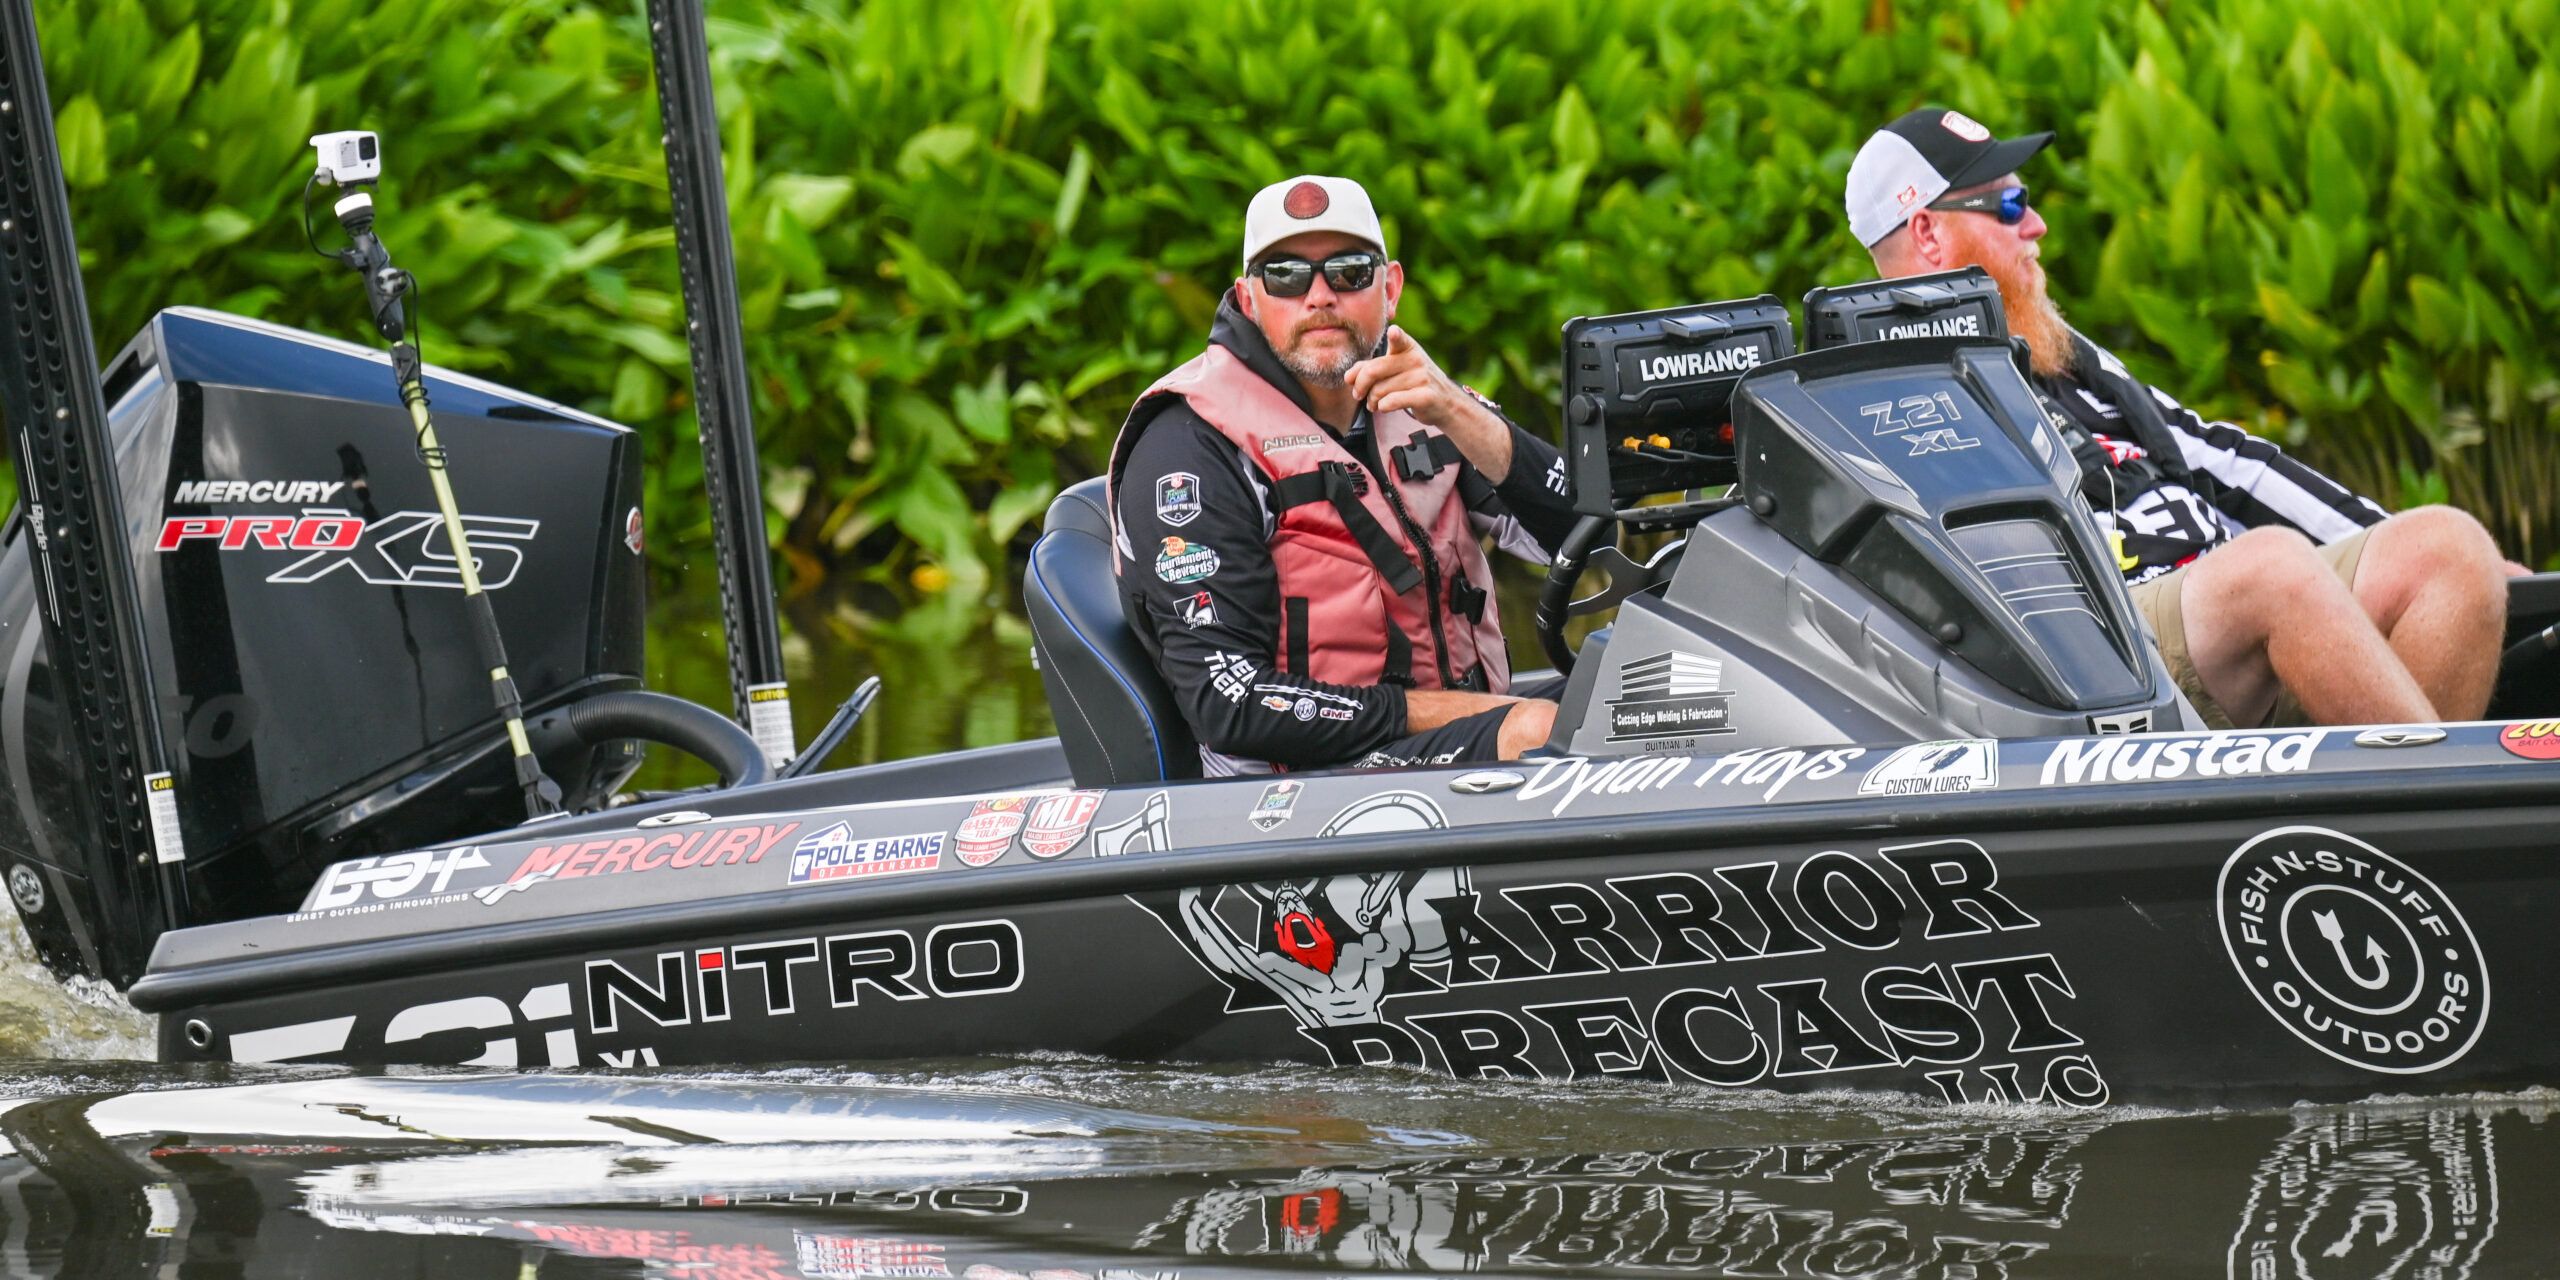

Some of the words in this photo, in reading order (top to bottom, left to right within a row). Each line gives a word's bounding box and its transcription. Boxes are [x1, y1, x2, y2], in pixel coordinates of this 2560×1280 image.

[1640, 345, 1761, 382] LOWRANCE
[1860, 390, 1962, 436] Z21
[1901, 428, 1981, 456] XL
[173, 481, 345, 504] MERCURY
[154, 516, 366, 552] PRO
[266, 508, 541, 591] XS
[1155, 549, 1213, 574] Tournament
[1168, 560, 1214, 583] Rewards
[1320, 708, 1353, 720] GMC
[1616, 713, 1640, 727] Cutting
[1641, 711, 1656, 726] Edge
[1656, 710, 1681, 724] Welding
[1682, 708, 1688, 721] &
[1688, 707, 1723, 720] Fabrication
[1685, 739, 1696, 748] AR
[2039, 730, 2329, 785] Mustad
[1516, 755, 1692, 818] Dylan
[1694, 746, 1867, 803] Hays
[1884, 778, 1933, 795] CUSTOM
[1933, 775, 1972, 793] LURES
[962, 816, 994, 832] BASS
[995, 814, 1020, 828] PRO
[1032, 794, 1096, 830] MLF
[975, 828, 1000, 838] TOUR
[1028, 831, 1043, 841] MAJOR
[1043, 830, 1061, 840] LEAGUE
[508, 821, 802, 883] MERCURY
[814, 842, 866, 868] POLE
[873, 834, 944, 862] BARNS
[818, 867, 836, 878] OF
[847, 858, 928, 876] ARKANSAS
[287, 911, 325, 923] BEAST
[329, 903, 385, 918] OUTDOOR
[390, 892, 469, 910] INNOVATIONS
[2273, 971, 2470, 1055] OUTDOORS
